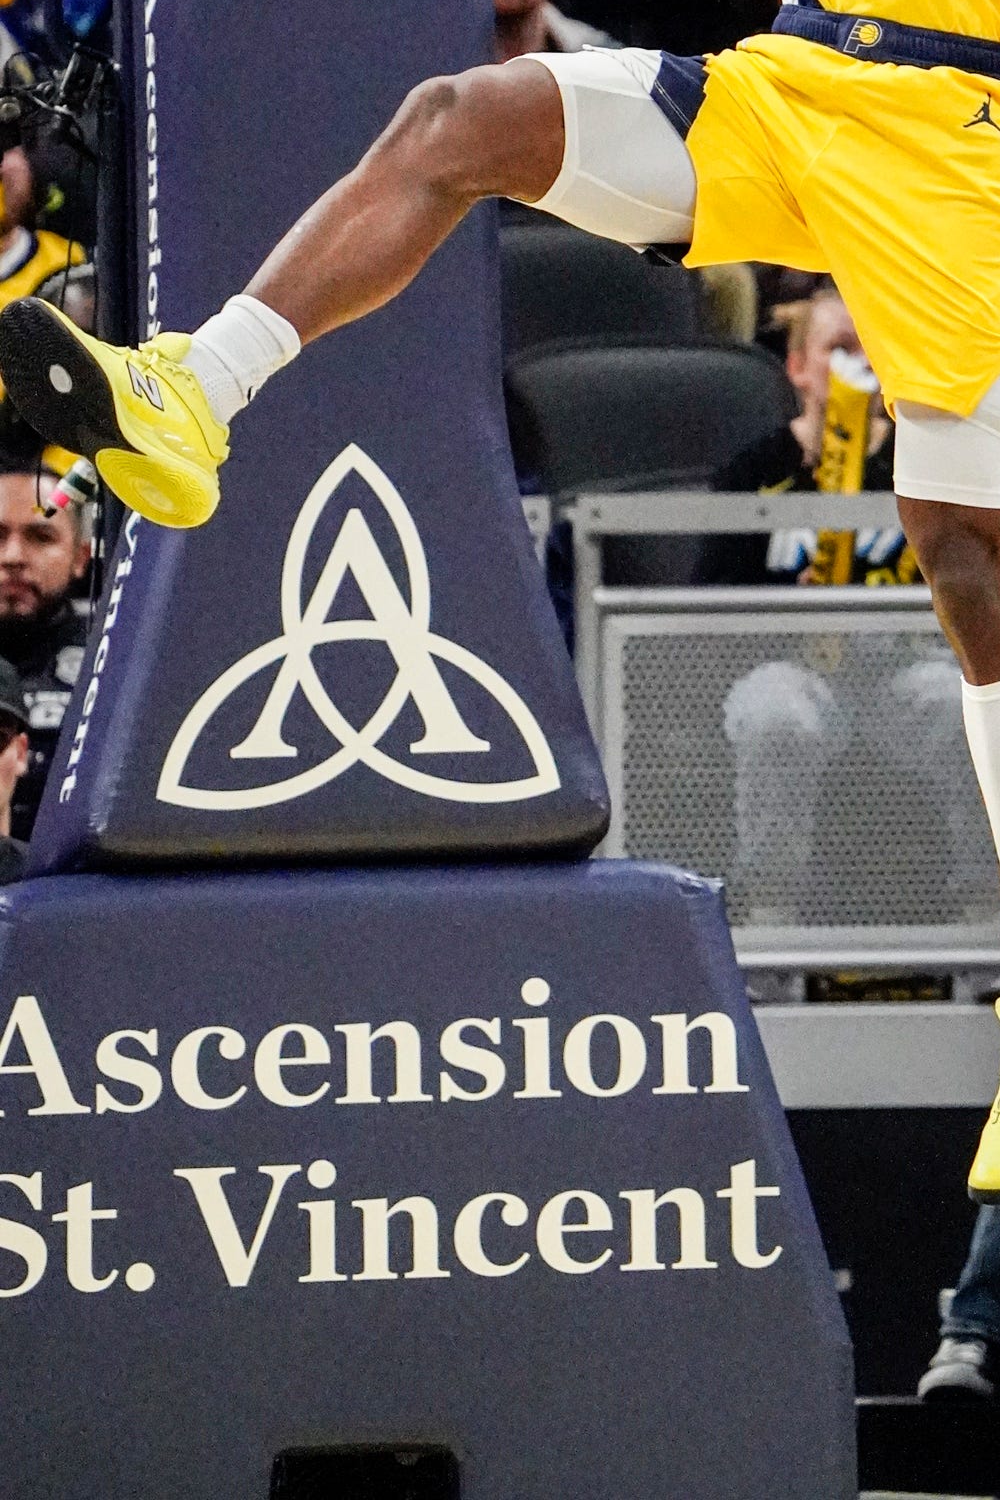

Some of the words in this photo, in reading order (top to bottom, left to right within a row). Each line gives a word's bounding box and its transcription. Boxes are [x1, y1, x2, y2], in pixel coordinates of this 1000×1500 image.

[0, 977, 750, 1118] Ascension
[0, 1171, 157, 1298] St.
[174, 1159, 783, 1288] Vincent
